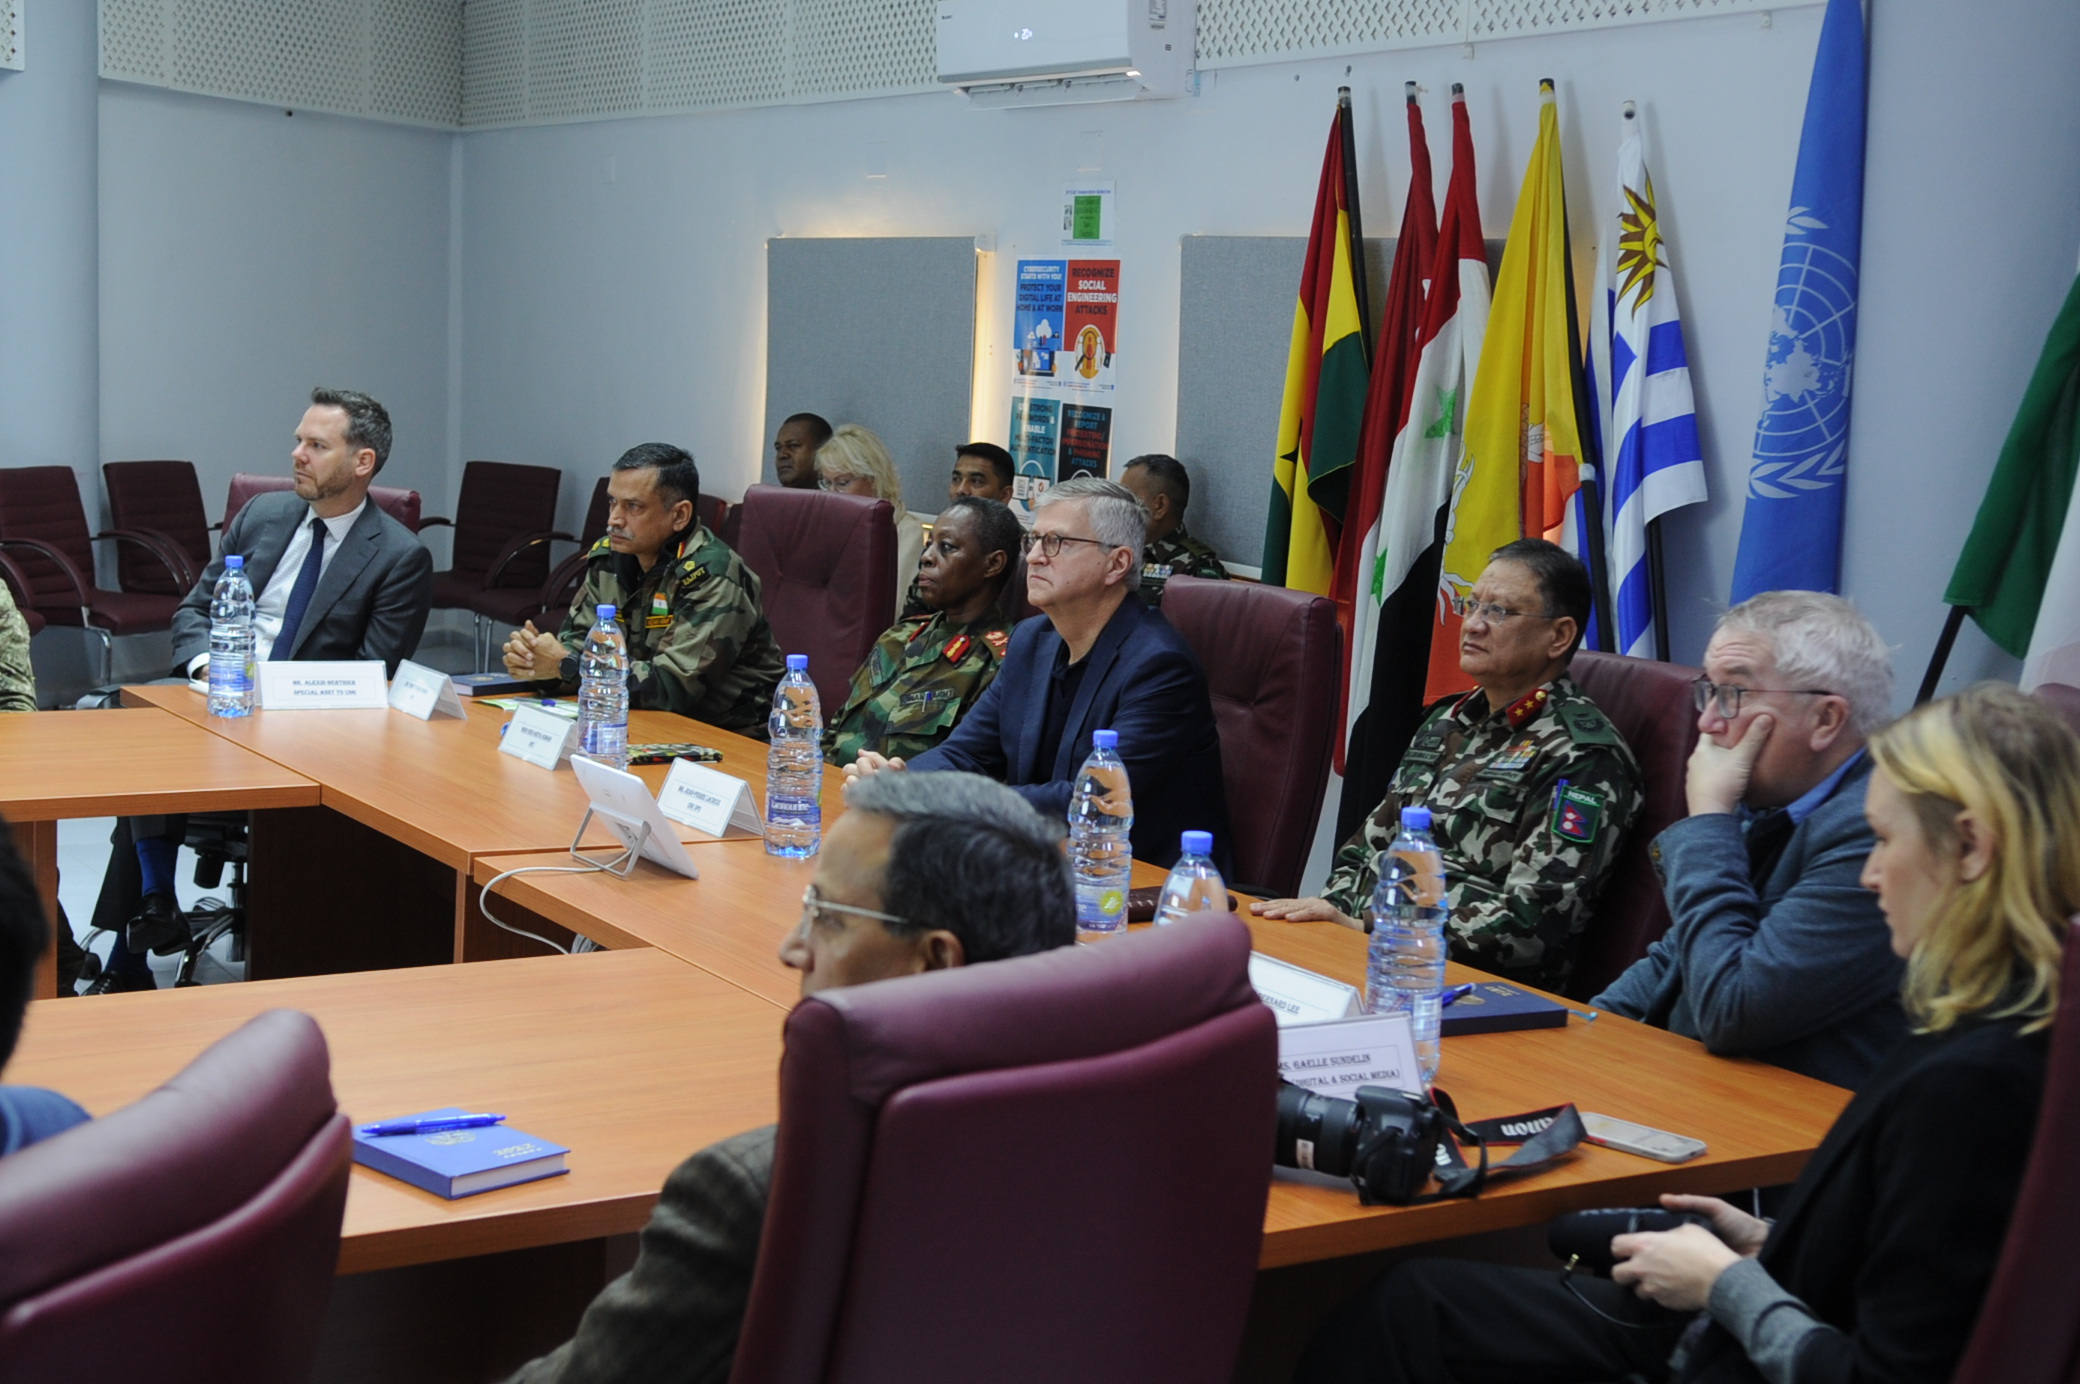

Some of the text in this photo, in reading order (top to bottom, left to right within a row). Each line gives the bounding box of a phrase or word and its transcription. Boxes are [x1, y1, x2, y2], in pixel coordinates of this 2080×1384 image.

[1072, 268, 1115, 278] RECOGNIZE
[1020, 283, 1062, 292] PROTECT YOUR
[1078, 280, 1106, 291] SOCIAL
[1019, 293, 1062, 302] DIGITAL LIFE AT
[1067, 292, 1118, 303] ENGINEERING
[1017, 304, 1031, 312] HOME
[1037, 304, 1044, 312] AT
[1046, 305, 1063, 313] WORK
[1075, 305, 1108, 315] ATTACKS
[1016, 413, 1050, 423] PAWORDS
[1067, 410, 1101, 421] RECOGNIZE
[1074, 420, 1098, 430] REPORT
[1567, 790, 1597, 804] NEPAL
[1287, 1003, 1300, 1014] LEE
[1293, 1057, 1328, 1069] GAELLE
[1331, 1054, 1371, 1067] SUNDELIN
[1332, 1076, 1338, 1084] &
[1339, 1073, 1369, 1083] SOCIAL
[1371, 1068, 1400, 1080] MEDIA)
[1500, 1116, 1553, 1137] anon
